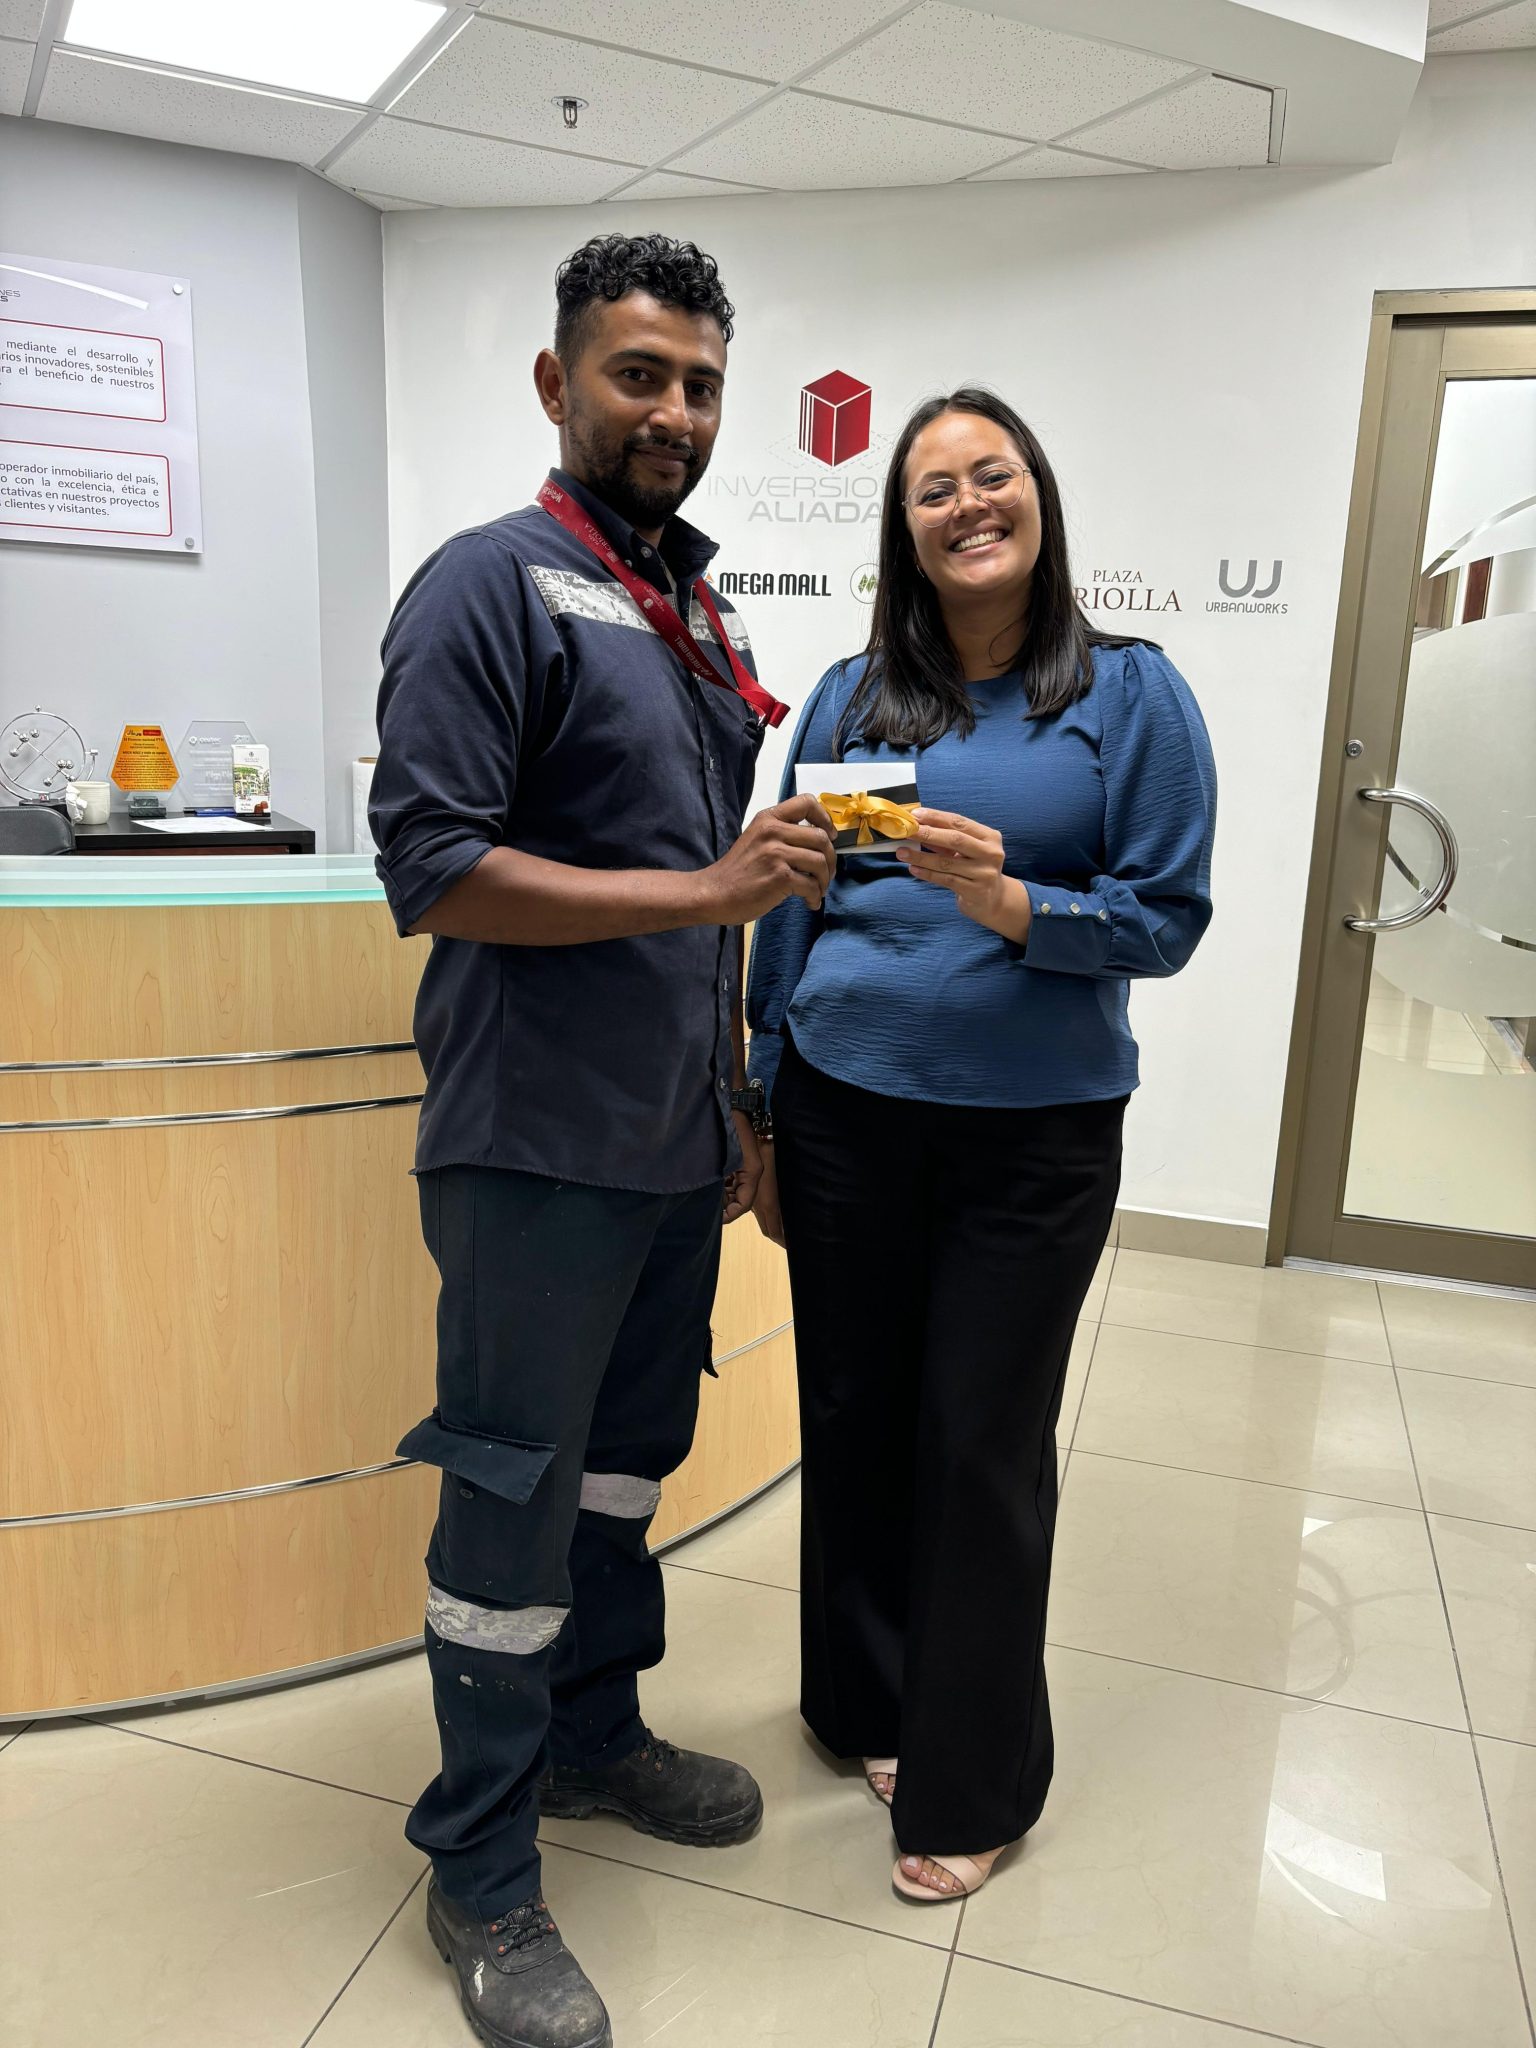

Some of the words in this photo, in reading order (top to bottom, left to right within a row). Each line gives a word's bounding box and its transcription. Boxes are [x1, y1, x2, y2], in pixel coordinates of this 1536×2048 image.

[0, 351, 21, 362] rios
[25, 353, 93, 371] innovadores,
[96, 363, 154, 378] sostenibles
[6, 340, 57, 353] mediante
[67, 346, 77, 356] el
[86, 348, 138, 364] desarrollo
[147, 358, 153, 367] y
[0, 366, 12, 374] ra
[18, 365, 28, 376] el
[35, 366, 84, 382] beneficio
[90, 374, 104, 384] de
[110, 377, 155, 390] nuestros
[0, 463, 48, 474] operador
[51, 465, 113, 480] inmobiliario
[116, 471, 132, 482] del
[135, 474, 159, 485] país,
[14, 476, 34, 485] con
[41, 476, 51, 487] la
[57, 479, 115, 494] excelencia,
[121, 484, 146, 495] ética
[152, 488, 159, 496] e
[0, 486, 42, 498] ctativas
[45, 491, 59, 499] en
[61, 491, 107, 504] nuestros
[109, 496, 160, 509] proyectos
[708, 475, 888, 499] INVERSIO
[4, 498, 46, 511] clientes
[48, 503, 55, 513] y
[57, 502, 110, 516] visitantes.
[747, 500, 881, 524] ALIADA
[719, 572, 775, 595] MEGA
[778, 573, 832, 597] MALL
[1092, 569, 1143, 583] PLAZA
[1073, 587, 1183, 612] RIOLLA
[1205, 601, 1289, 615] URBANWORKS
